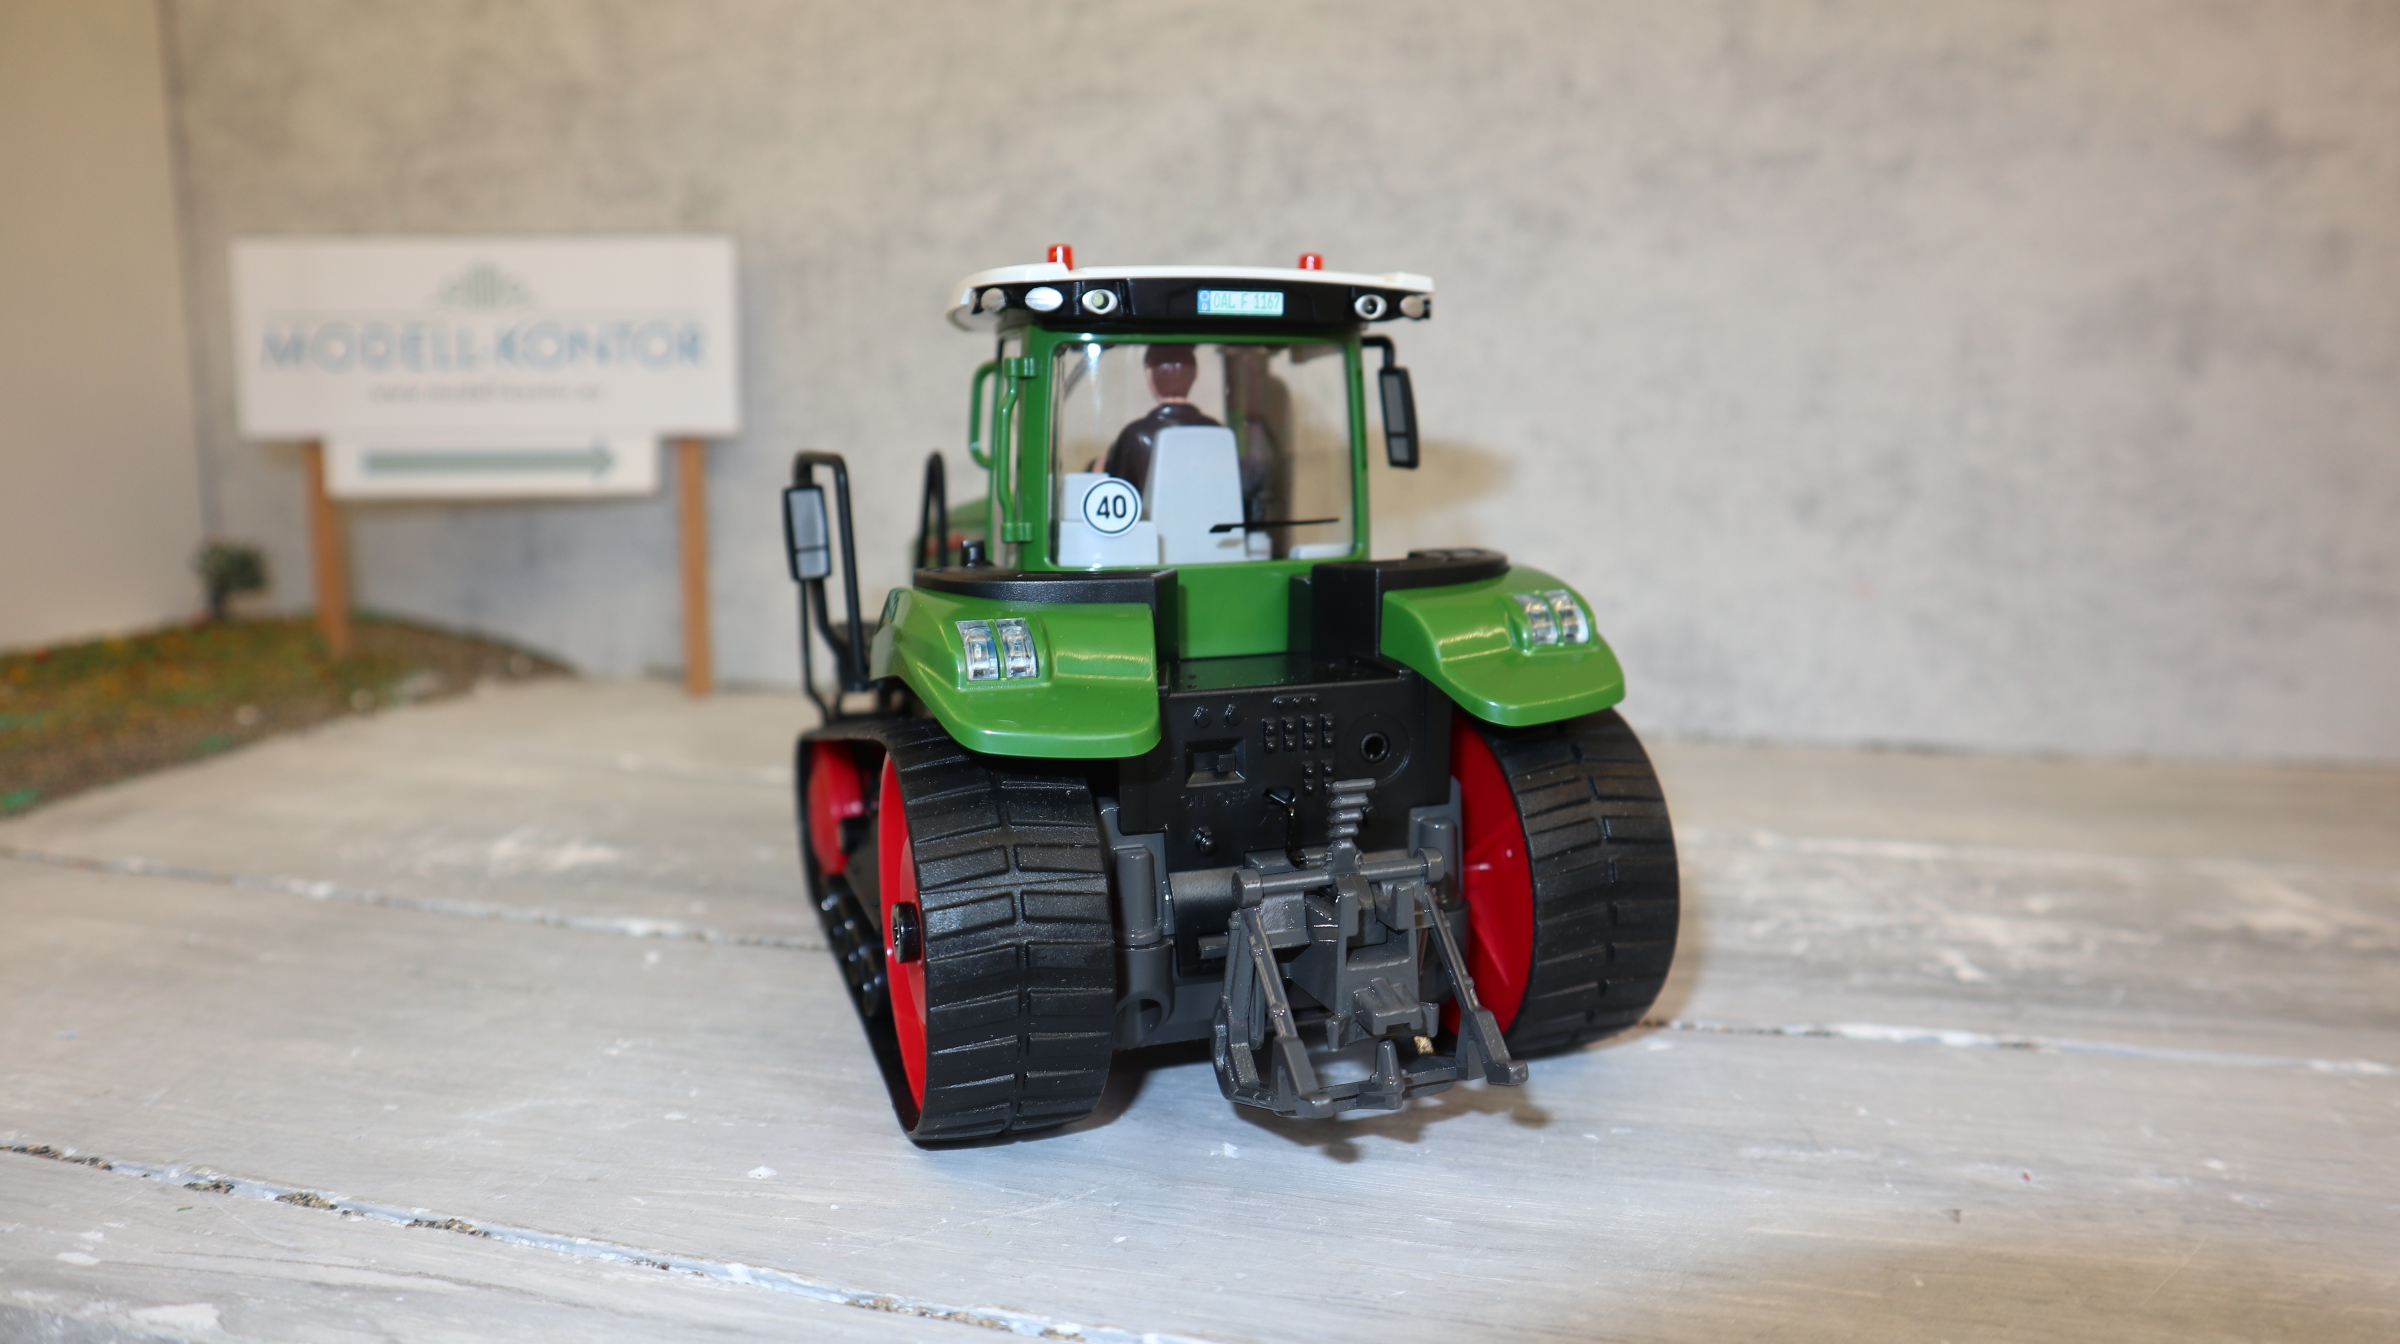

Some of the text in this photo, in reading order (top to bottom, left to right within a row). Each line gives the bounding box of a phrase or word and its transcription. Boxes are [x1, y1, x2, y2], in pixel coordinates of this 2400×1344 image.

[1213, 292, 1235, 309] OAL
[1240, 292, 1249, 309] F
[1254, 293, 1280, 310] 1167
[1096, 494, 1127, 519] 40
[1179, 788, 1253, 808] ON OFF
